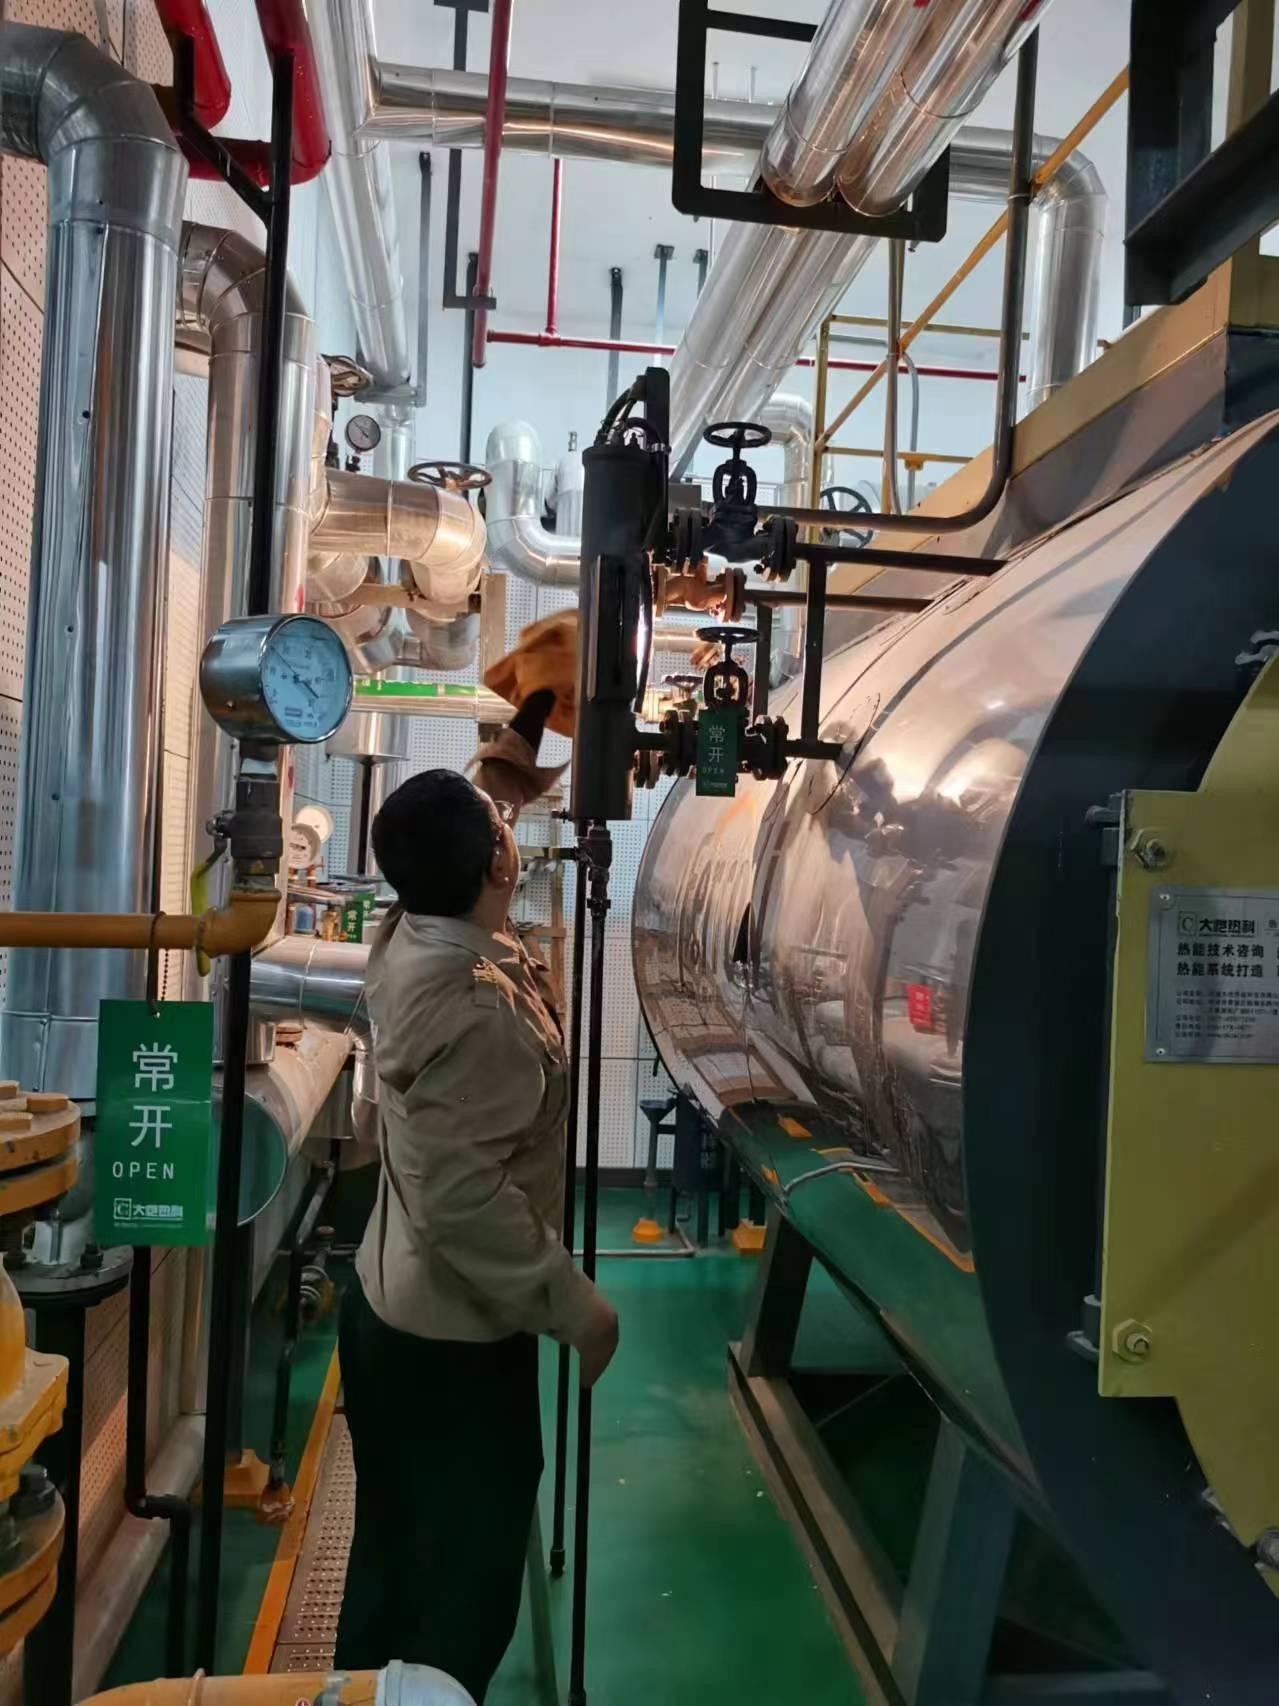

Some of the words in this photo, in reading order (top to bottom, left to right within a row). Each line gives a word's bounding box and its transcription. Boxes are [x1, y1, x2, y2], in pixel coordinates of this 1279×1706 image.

[708, 725, 726, 763] 常开
[1177, 943, 1264, 958] 热能技术咨询
[1176, 962, 1263, 977] 热能系统打造
[129, 1042, 178, 1148] 常开
[112, 1161, 174, 1179] OPEN
